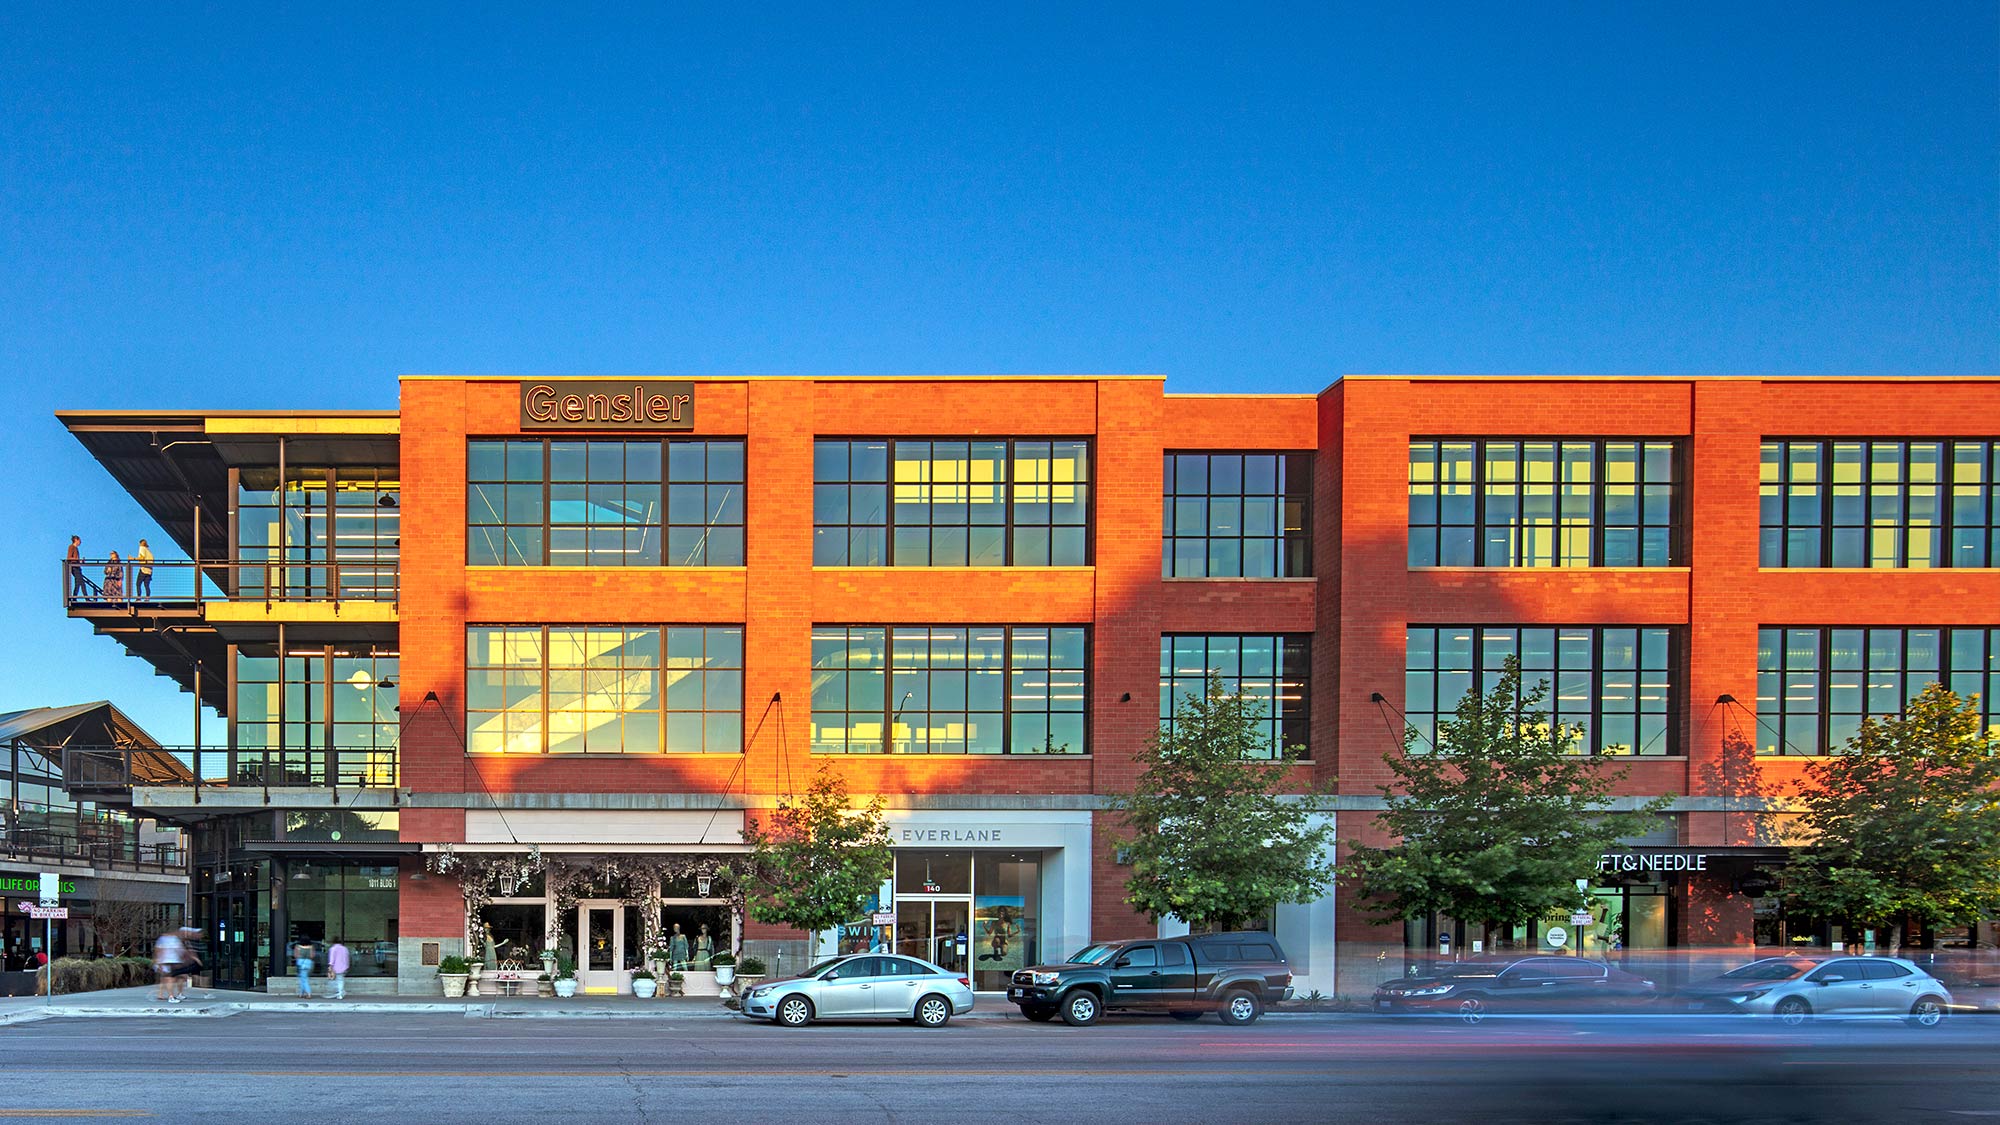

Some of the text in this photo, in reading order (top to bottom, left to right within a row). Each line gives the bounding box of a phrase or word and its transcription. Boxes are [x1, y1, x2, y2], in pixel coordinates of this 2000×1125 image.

[525, 385, 689, 421] Gensler
[902, 830, 1001, 841] EVERLANE
[25, 879, 76, 893] ORICS
[838, 926, 880, 936] SWIM
